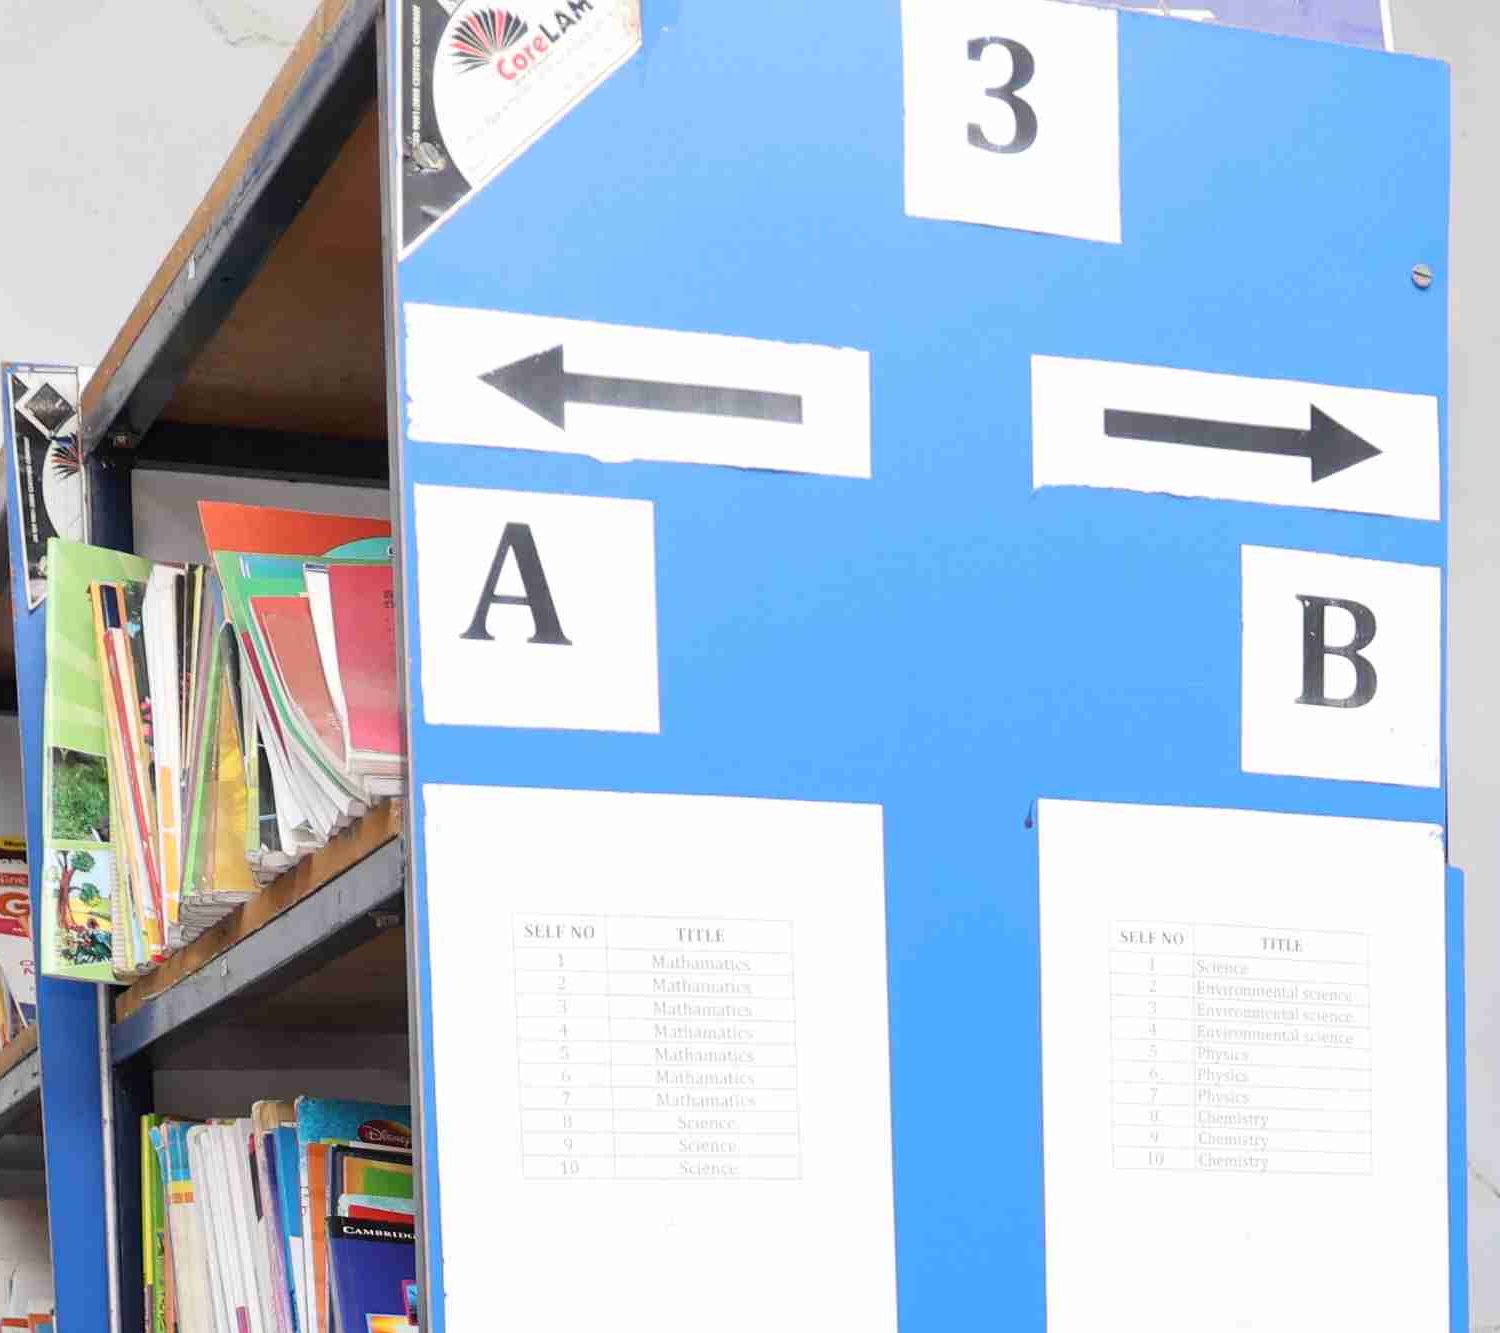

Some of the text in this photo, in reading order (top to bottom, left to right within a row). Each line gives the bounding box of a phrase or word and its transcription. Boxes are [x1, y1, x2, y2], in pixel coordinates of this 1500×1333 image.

[966, 36, 1039, 154] 3
[459, 521, 573, 647] A
[1295, 593, 1378, 710] B
[523, 920, 595, 939] SELF NO
[676, 926, 725, 944] TITLE
[1162, 931, 1185, 946] NO
[1260, 936, 1303, 952] TITLE
[342, 1225, 420, 1242] CAMBRIDG
